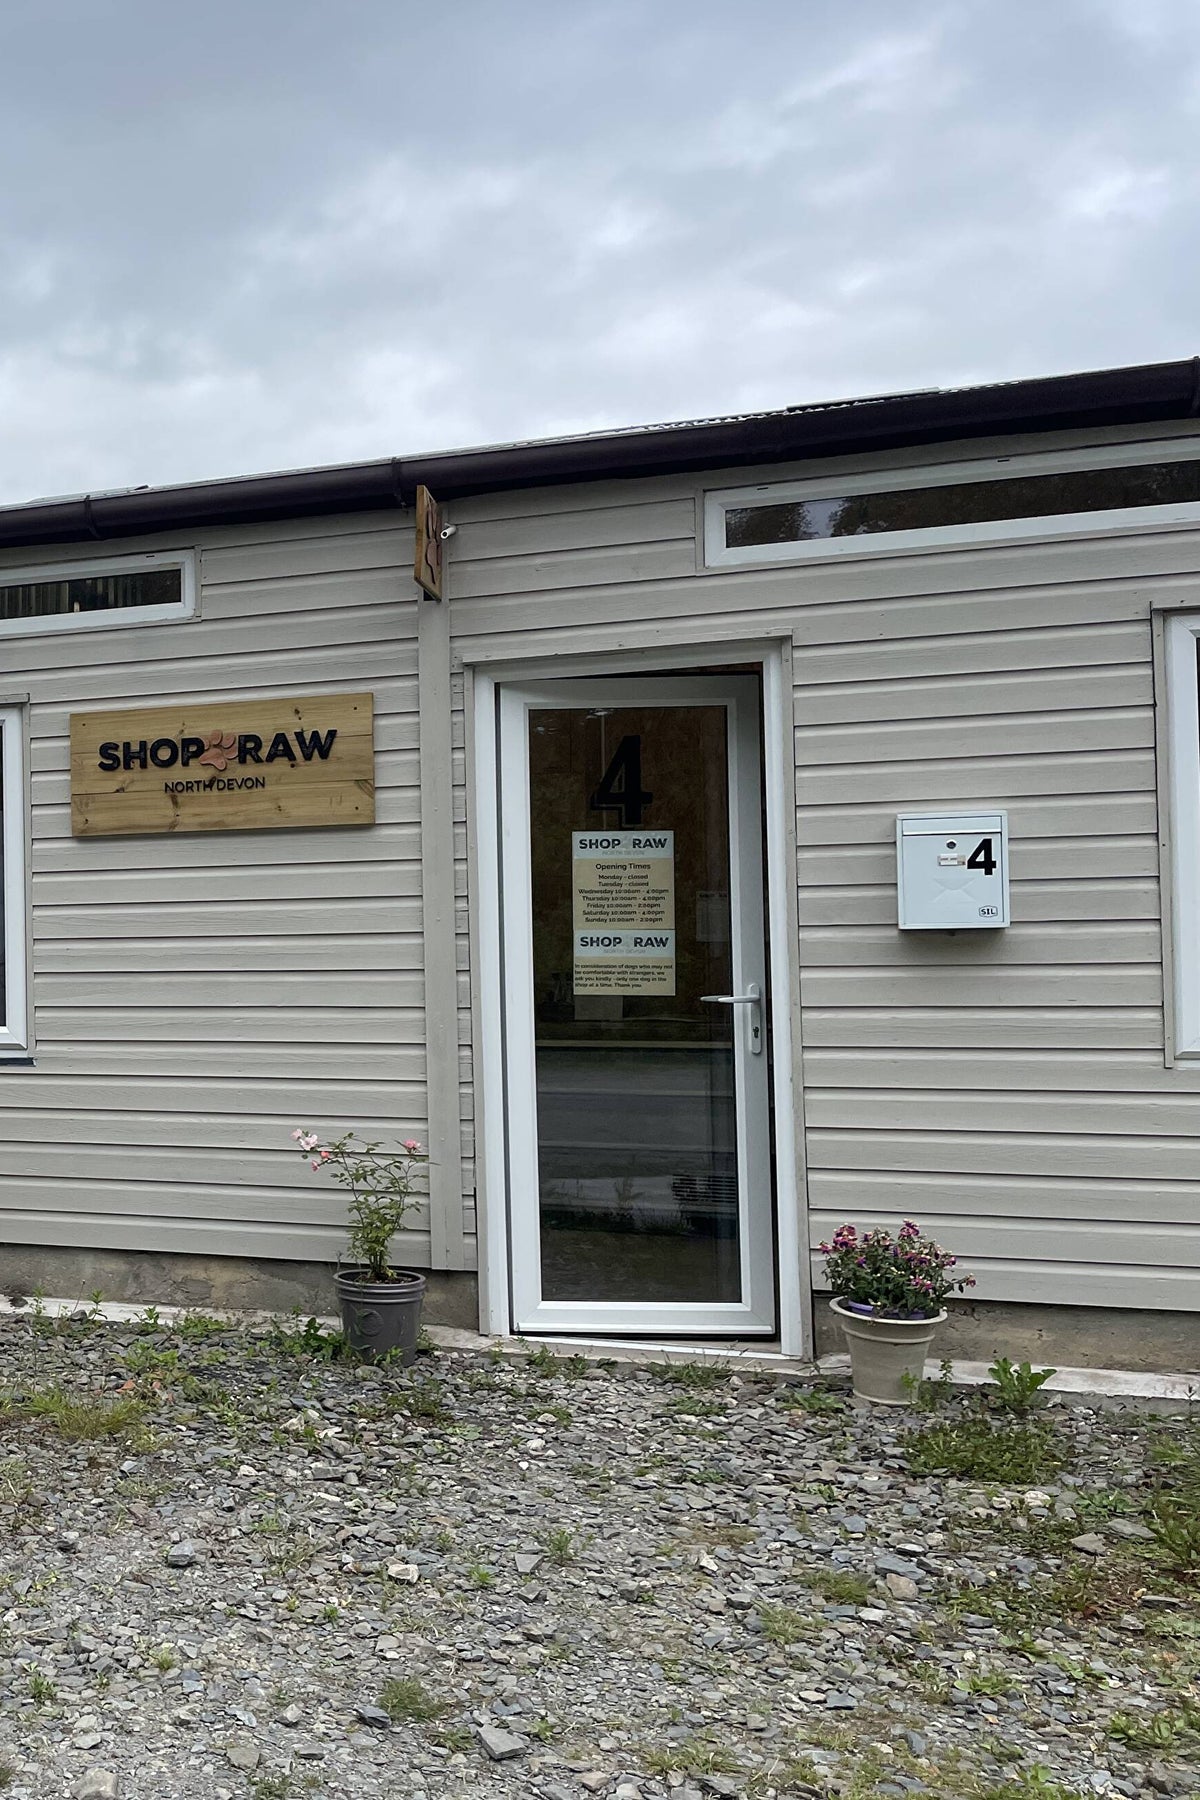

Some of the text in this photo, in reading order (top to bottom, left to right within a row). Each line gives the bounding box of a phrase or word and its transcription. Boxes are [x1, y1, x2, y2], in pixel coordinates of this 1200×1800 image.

[98, 729, 337, 771] SHOP RAW
[165, 776, 266, 793] NORTH DEVON
[592, 735, 653, 827] 4
[579, 838, 668, 849] SHOP RAW
[967, 838, 996, 875] 4
[580, 937, 669, 947] SHOP RAW
